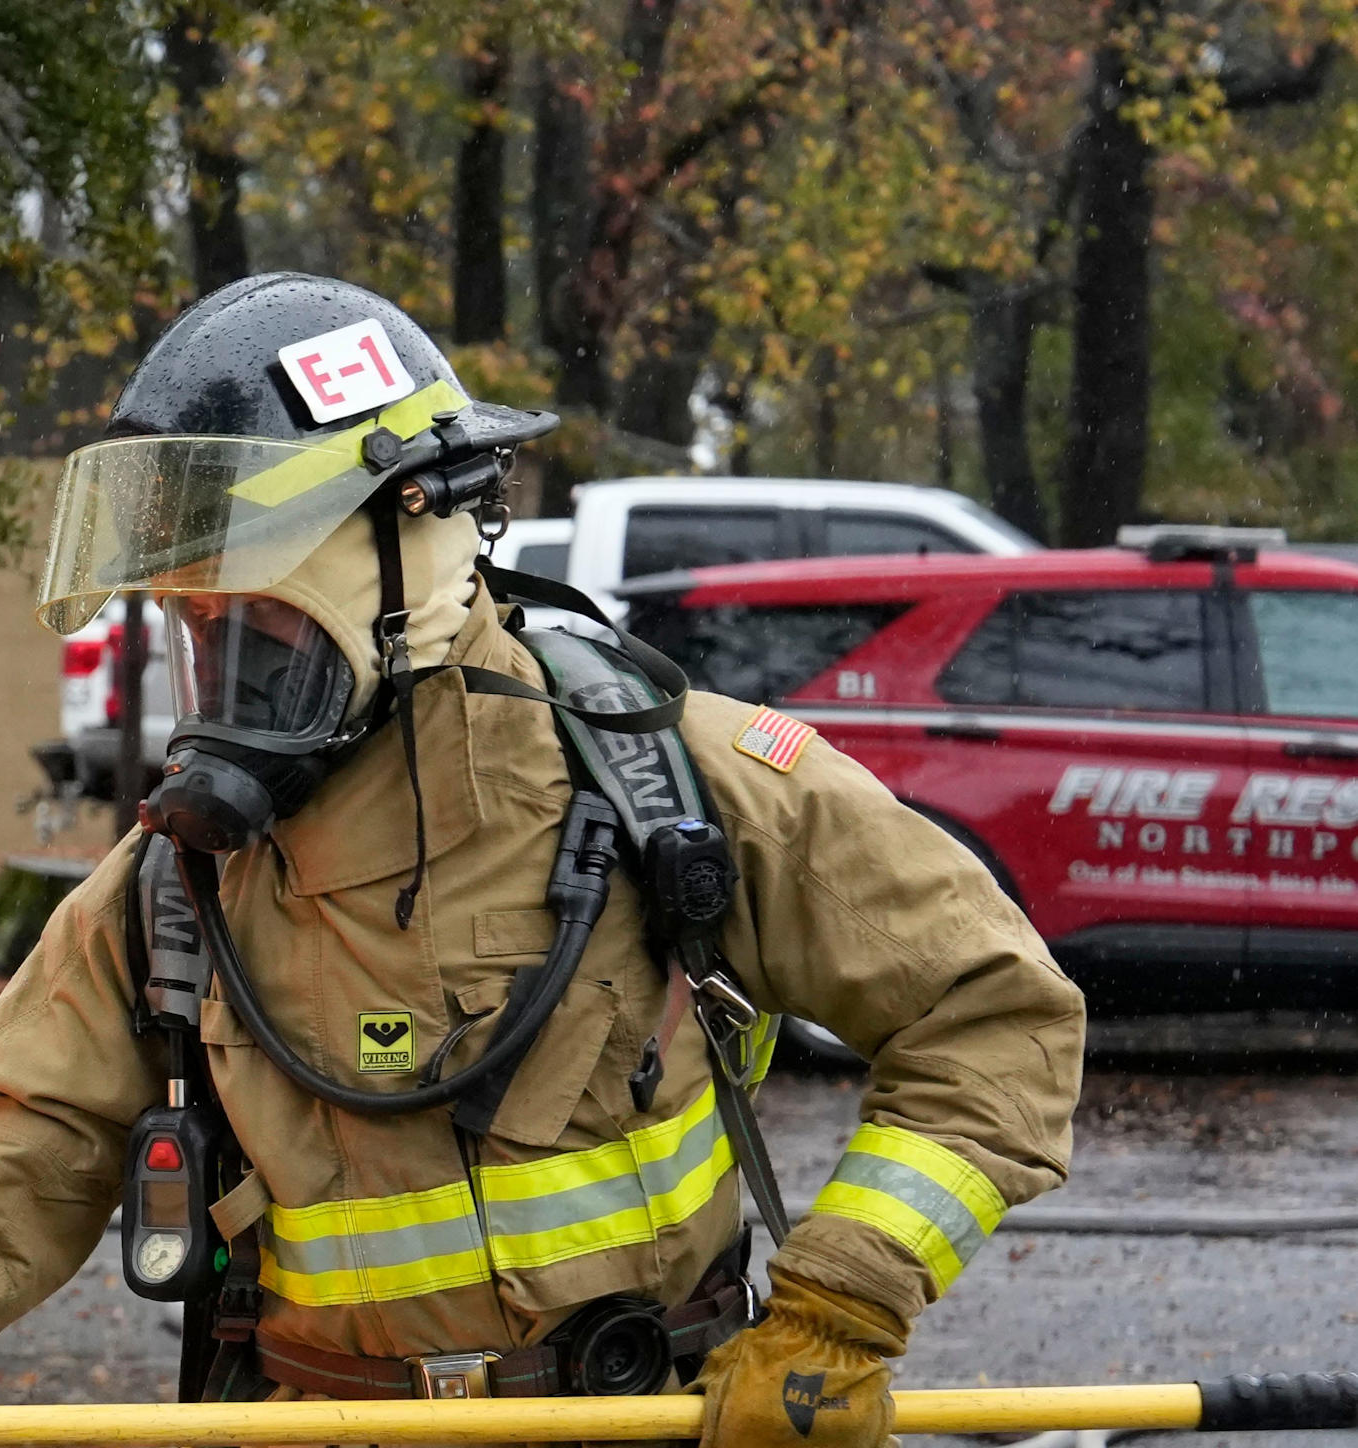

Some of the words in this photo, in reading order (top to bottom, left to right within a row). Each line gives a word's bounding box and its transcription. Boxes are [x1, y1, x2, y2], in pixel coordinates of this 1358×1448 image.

[297, 335, 396, 407] E-1
[1047, 764, 1219, 820] FIRE
[363, 1052, 408, 1065] VIKING
